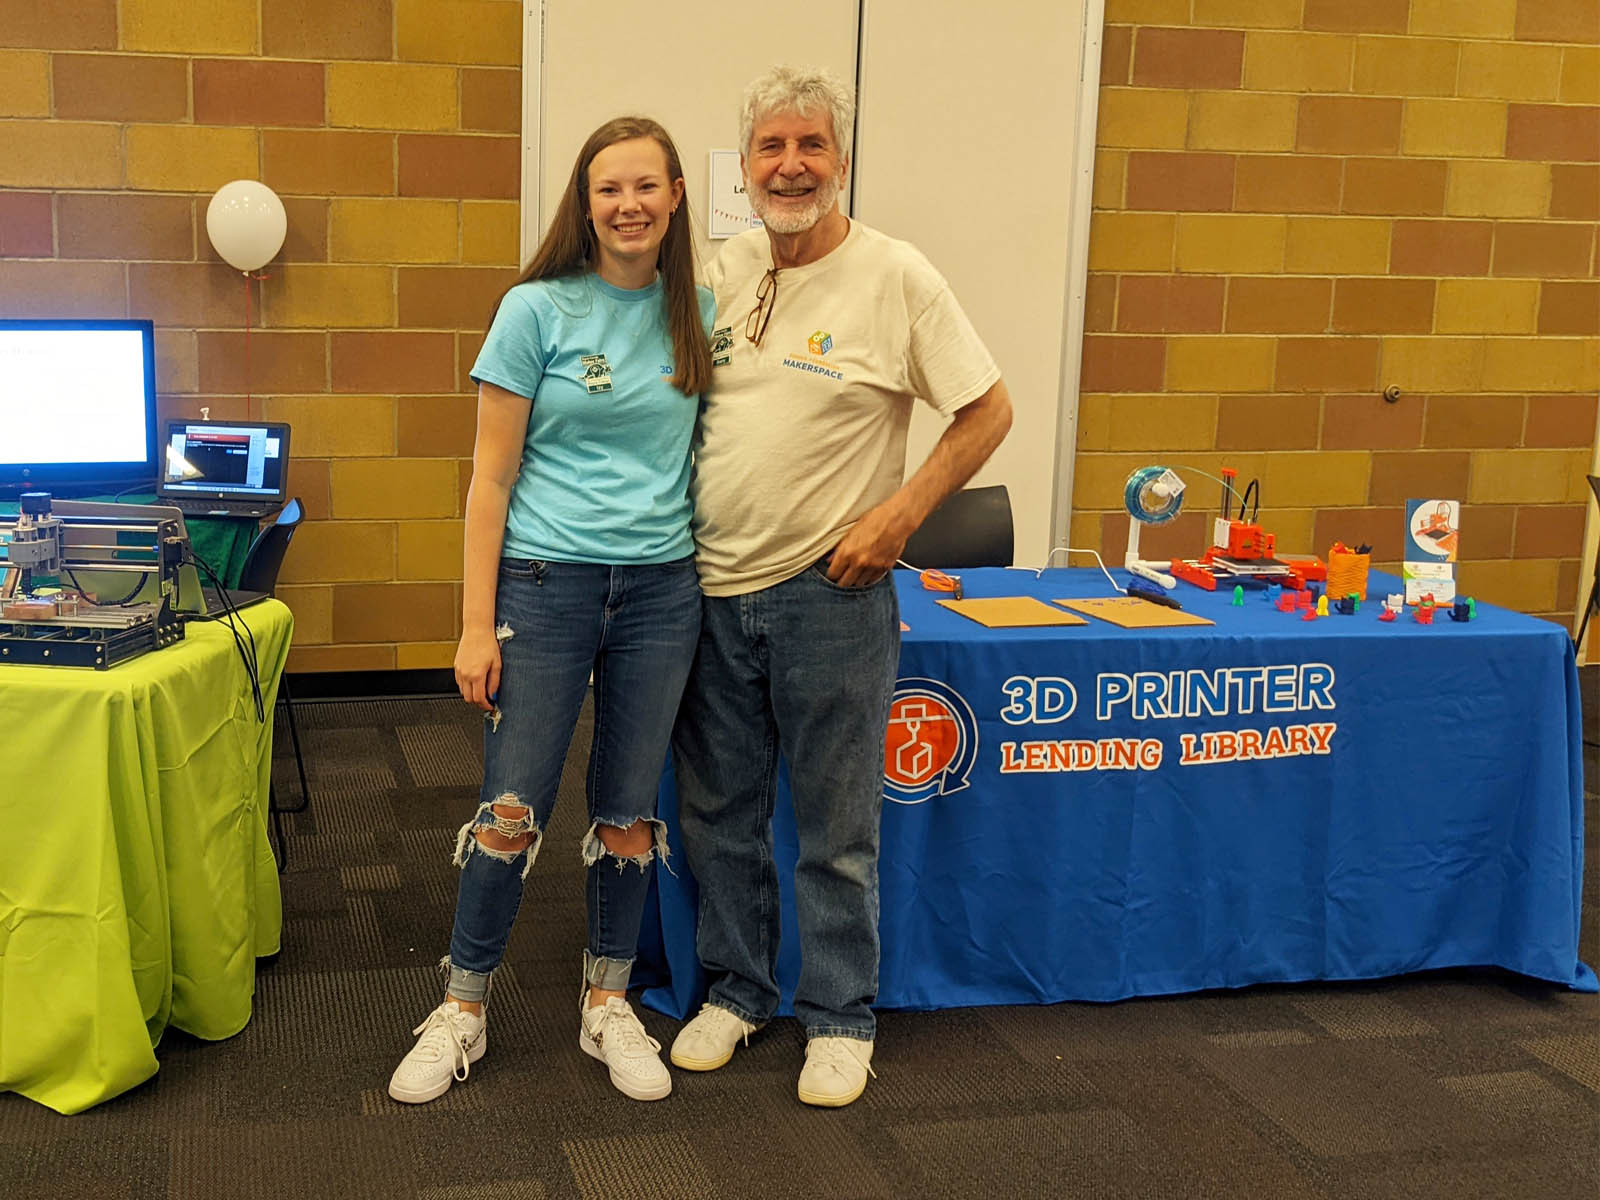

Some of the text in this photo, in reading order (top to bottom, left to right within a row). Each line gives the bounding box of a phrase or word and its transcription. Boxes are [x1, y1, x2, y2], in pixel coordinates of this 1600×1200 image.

[660, 365, 673, 374] 3D
[782, 358, 844, 380] MAKERSPACE
[1000, 662, 1337, 726] 3D PRINTER
[999, 722, 1337, 774] LENDING LIBRARY
